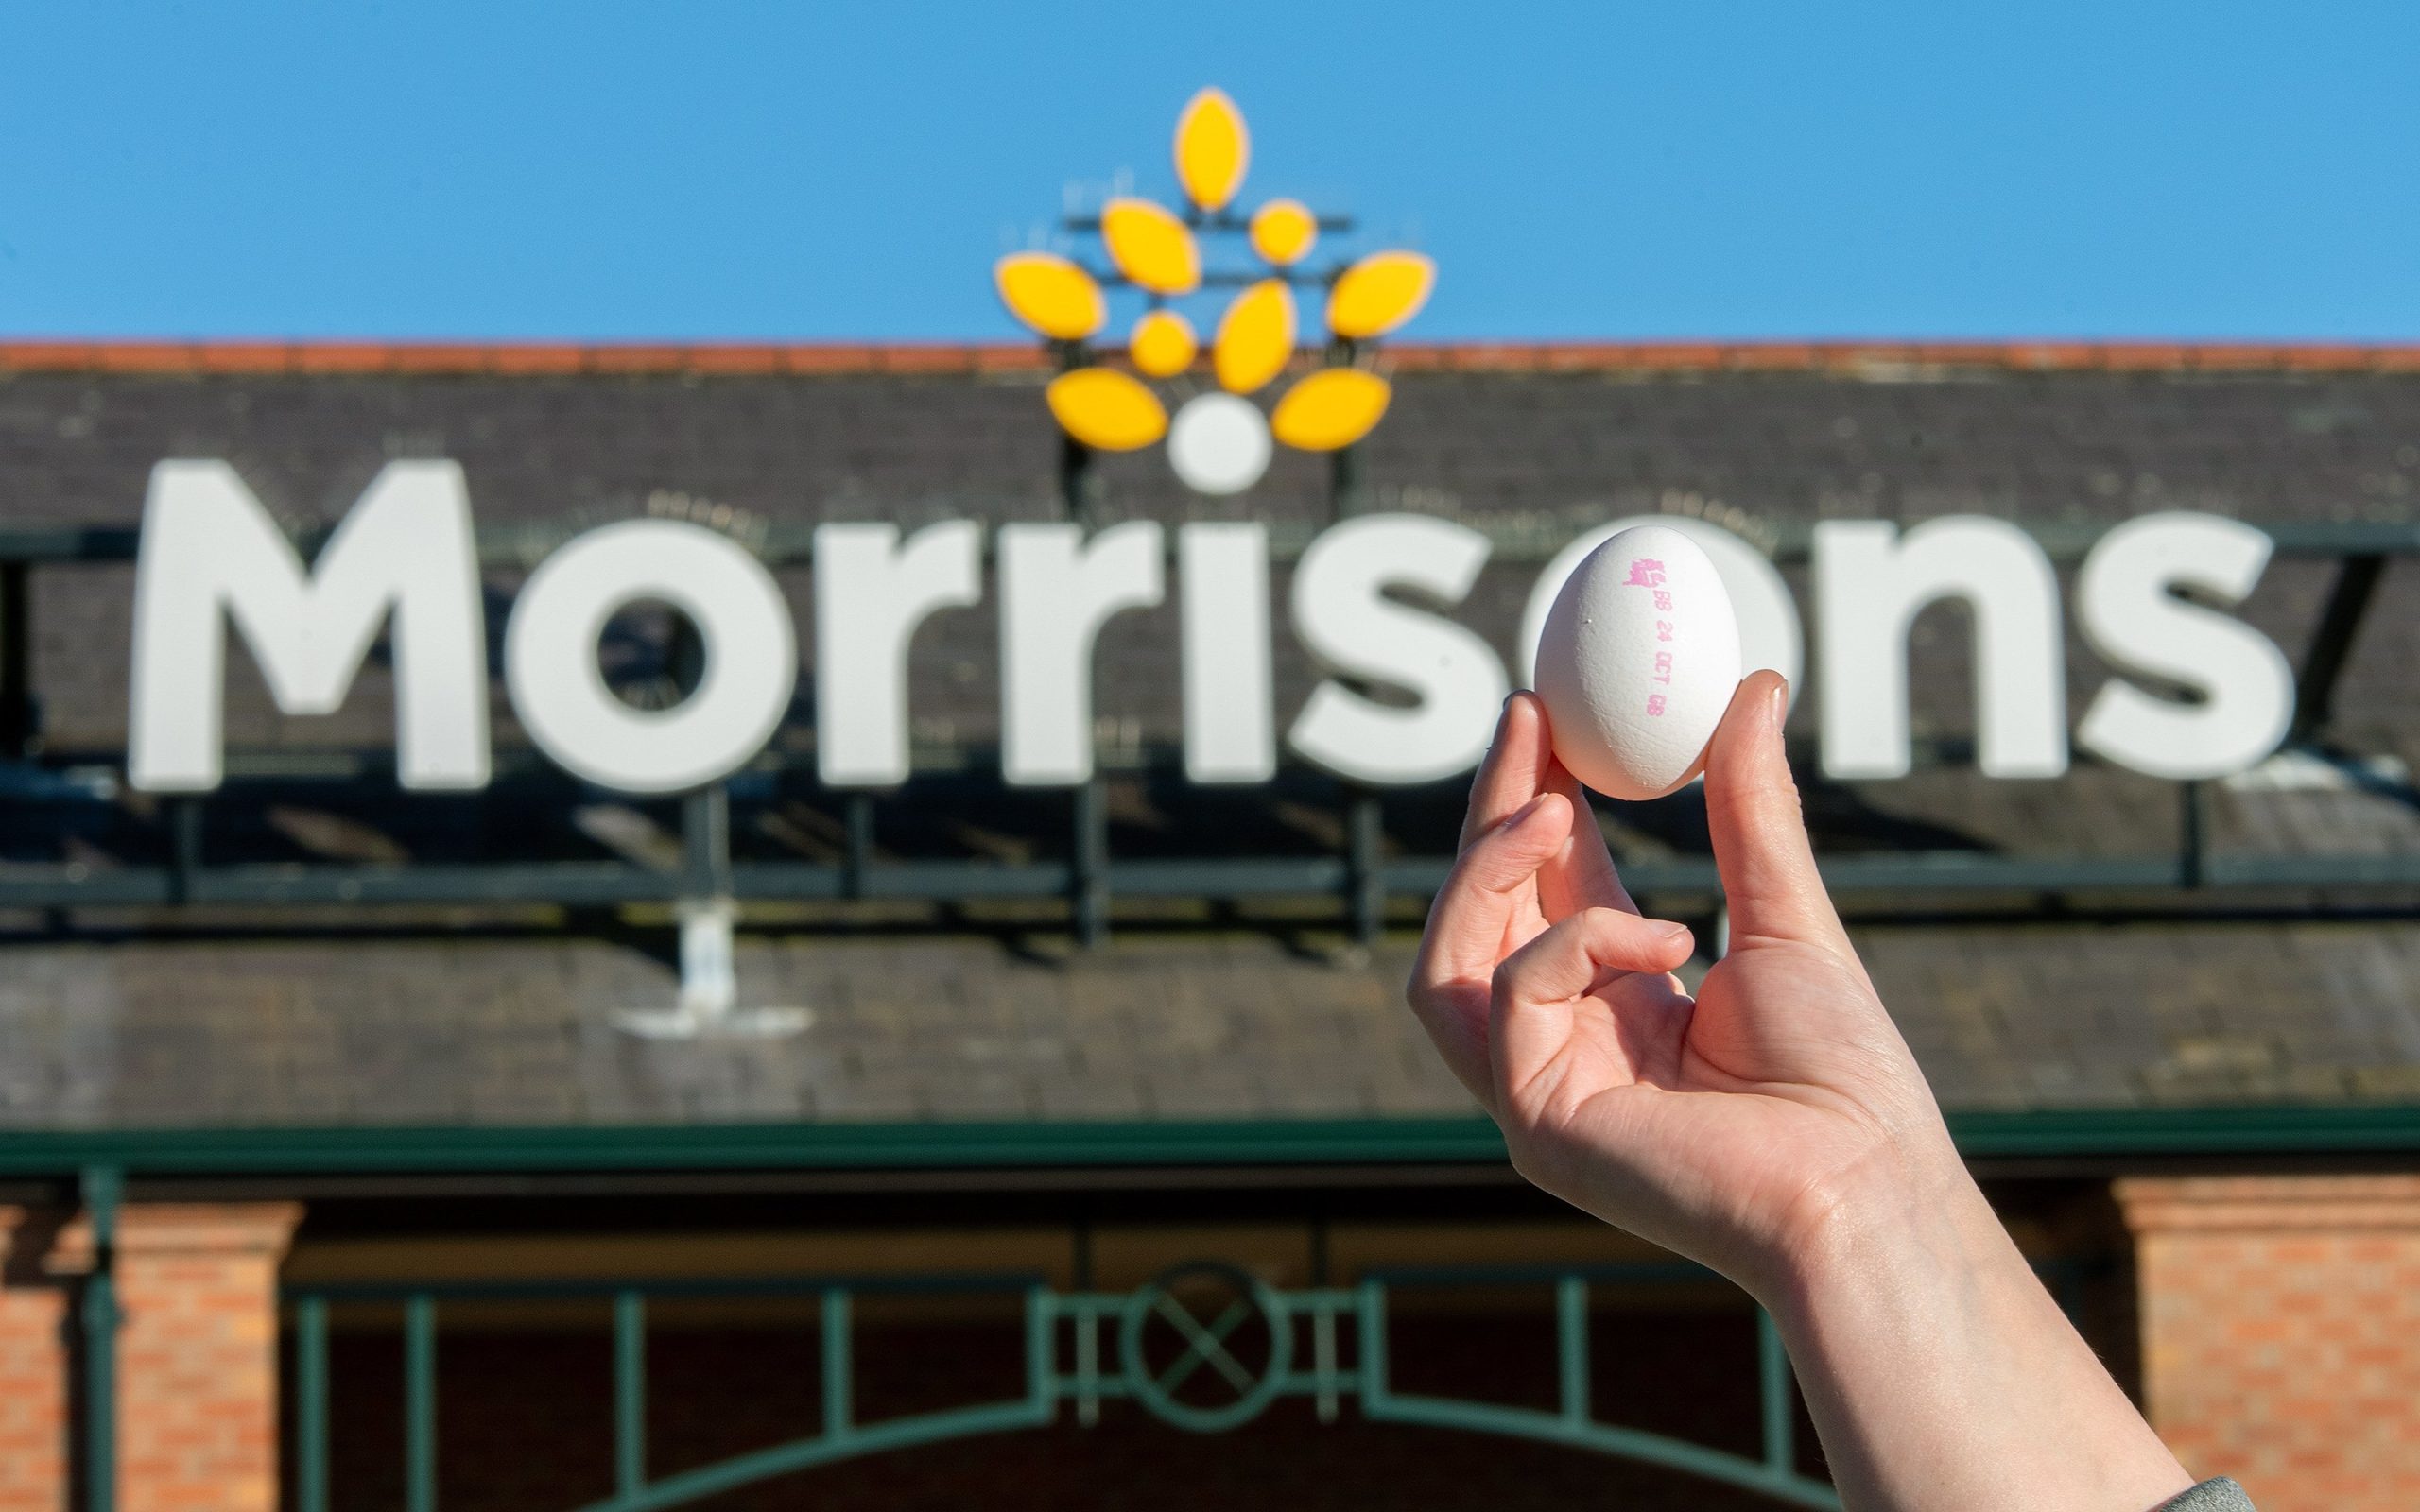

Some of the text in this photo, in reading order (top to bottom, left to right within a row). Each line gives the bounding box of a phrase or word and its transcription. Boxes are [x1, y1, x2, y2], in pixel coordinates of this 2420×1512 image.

[1653, 590, 1673, 611] BB
[1656, 620, 1673, 642] 24
[1654, 651, 1673, 685] OCT
